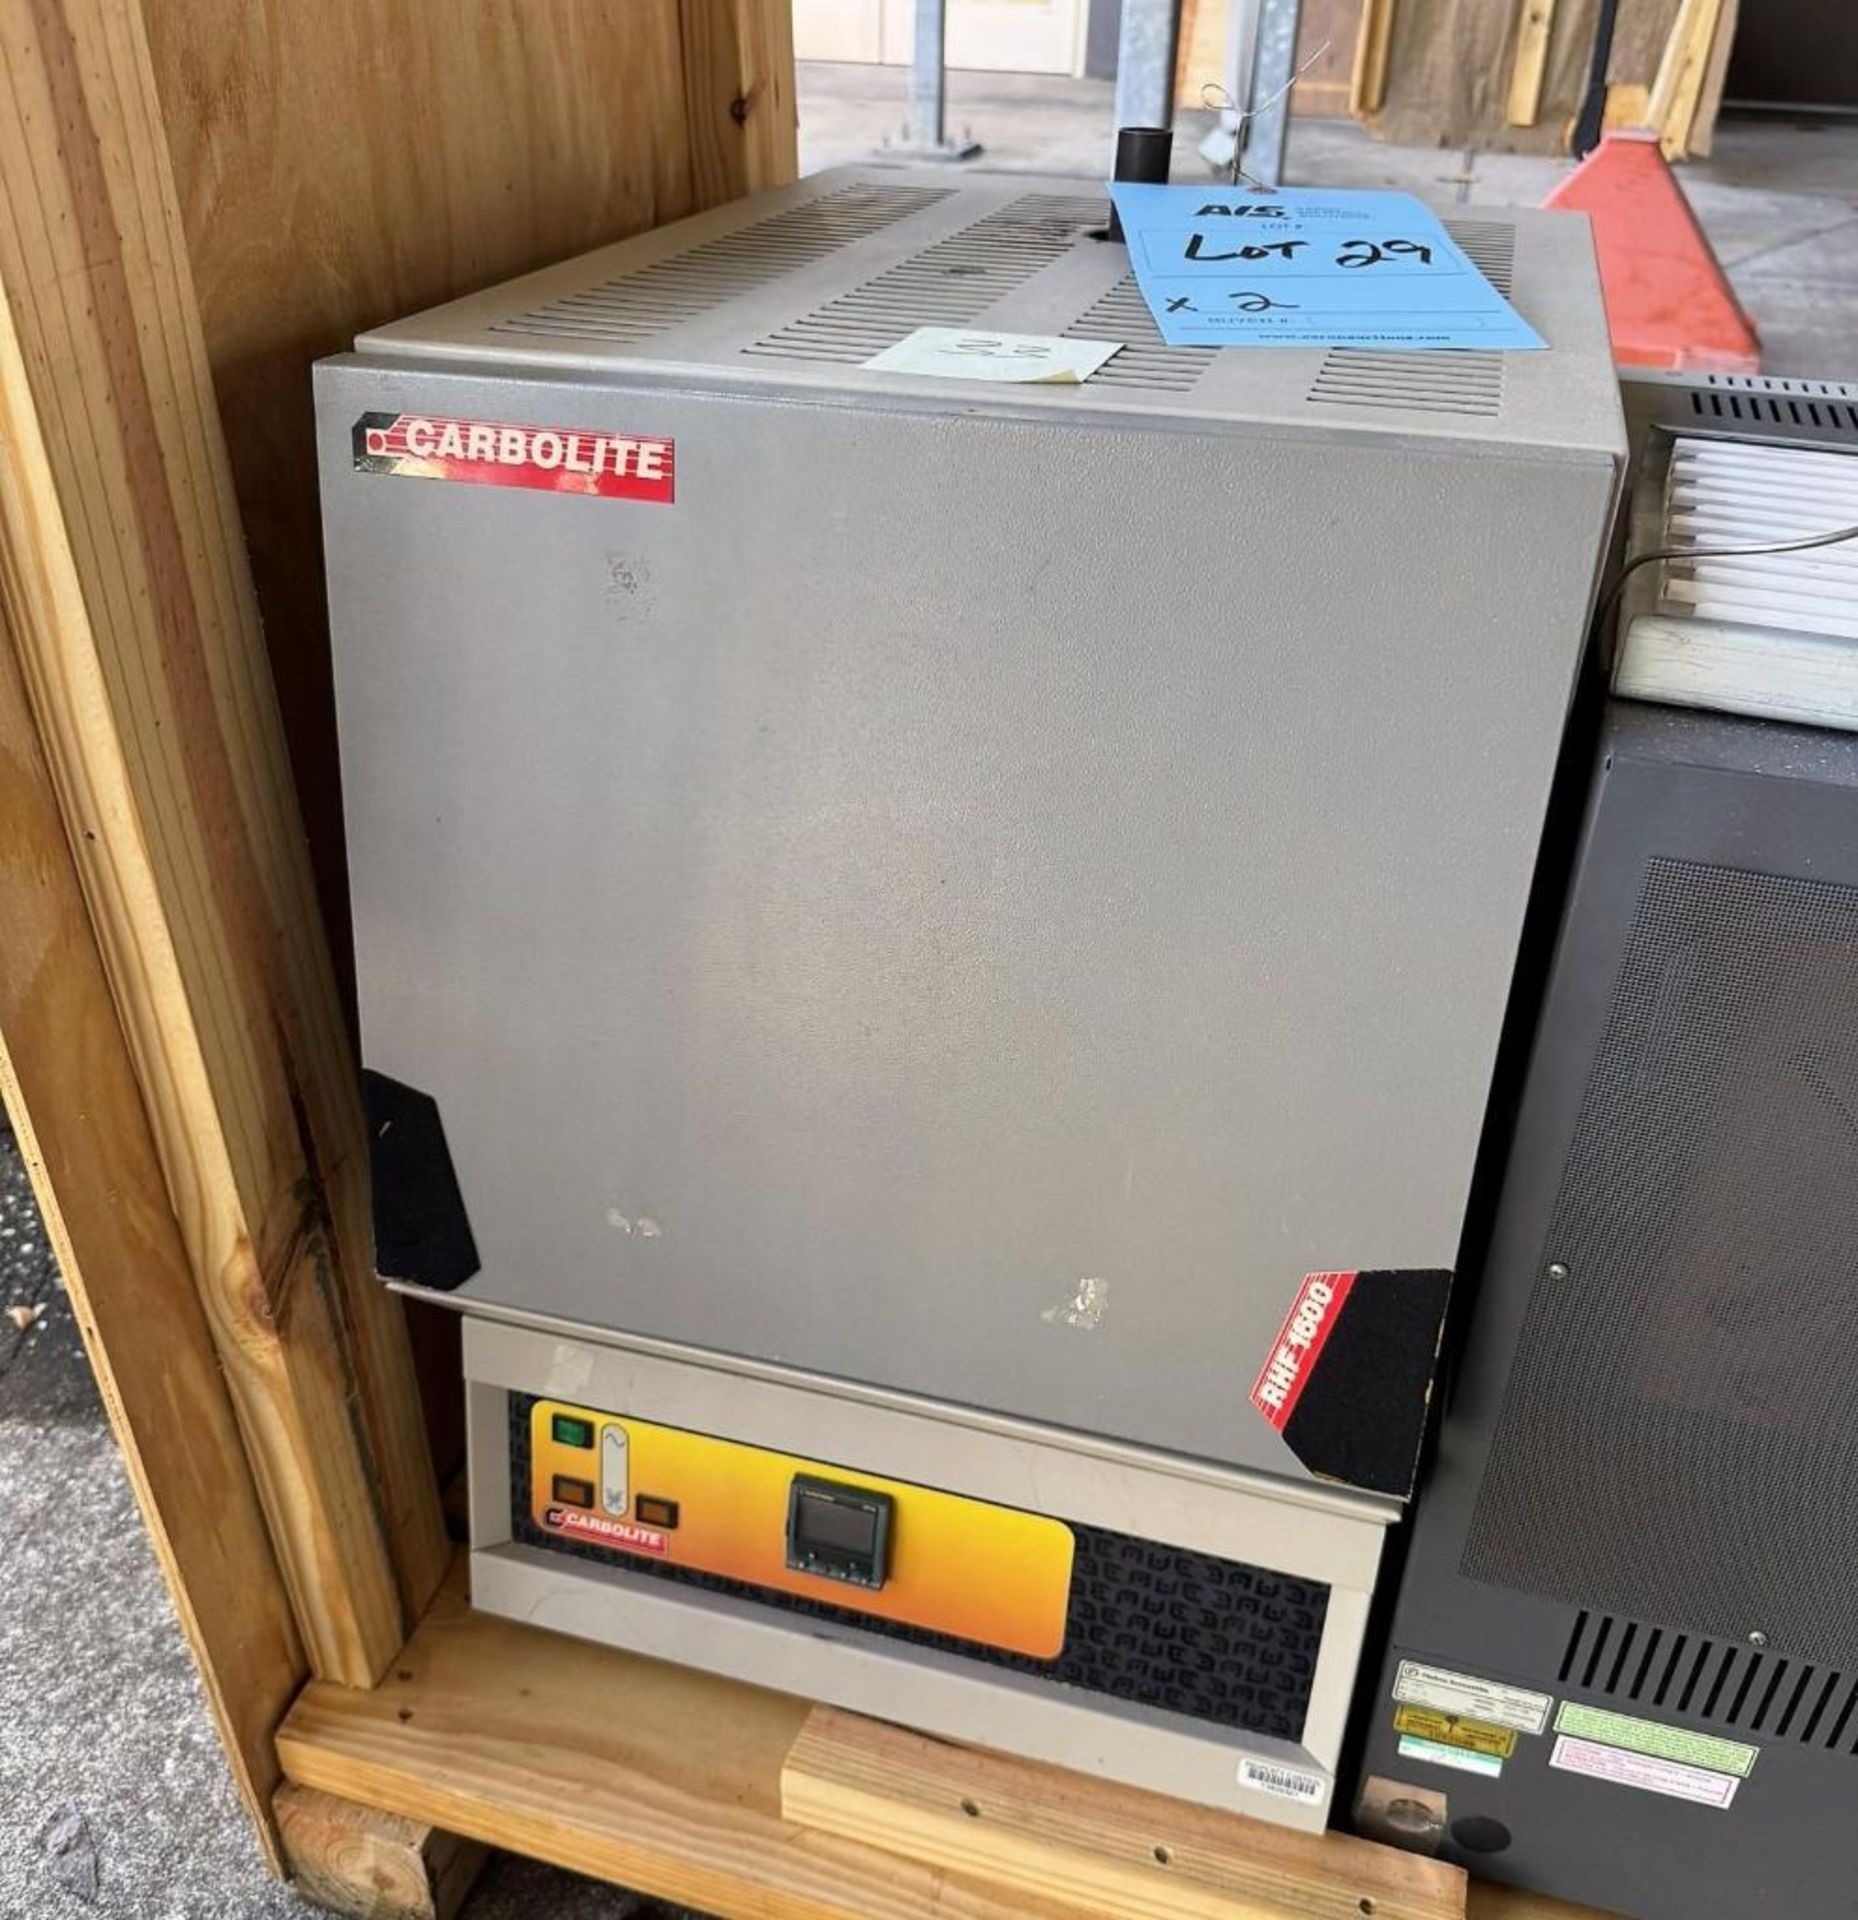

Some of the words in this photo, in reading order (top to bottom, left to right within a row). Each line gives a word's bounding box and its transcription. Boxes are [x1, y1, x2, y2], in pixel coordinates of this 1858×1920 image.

[1335, 239, 1433, 268] 29
[1228, 291, 1300, 312] 2
[407, 419, 666, 479] CARBOLITE
[1258, 1344, 1298, 1408] RHF
[1288, 1282, 1332, 1349] 1600
[565, 1512, 662, 1545] CARBOLITE
